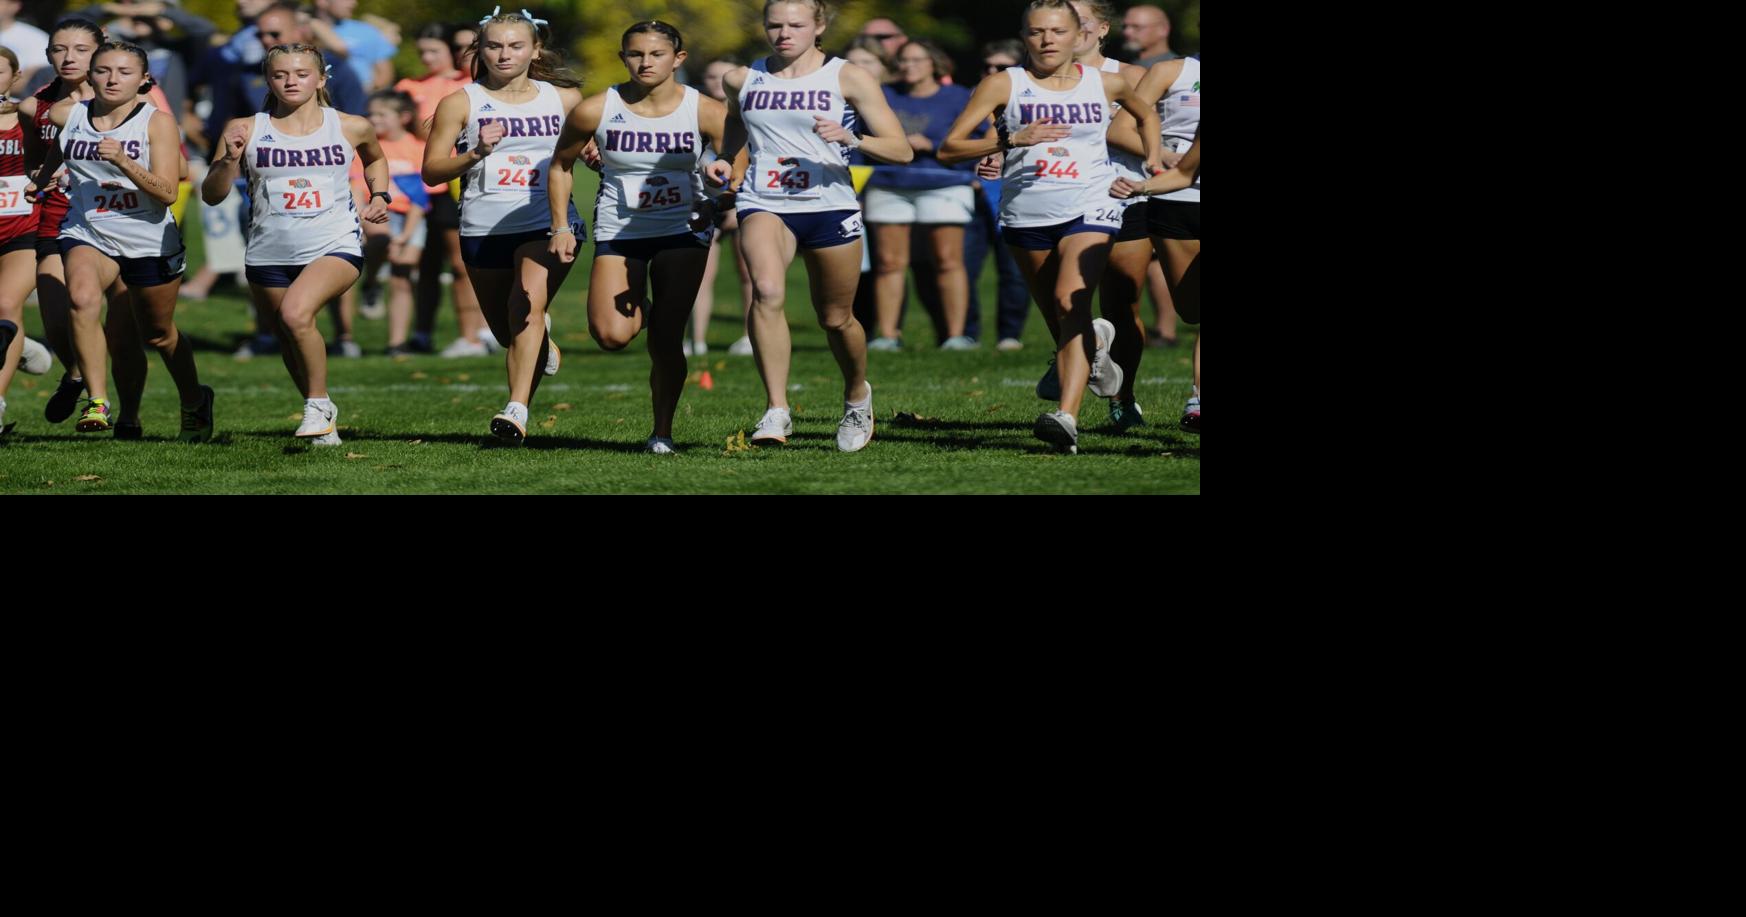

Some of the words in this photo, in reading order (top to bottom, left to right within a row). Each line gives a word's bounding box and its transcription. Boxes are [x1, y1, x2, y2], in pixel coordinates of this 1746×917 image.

[742, 89, 831, 112] NORRIS
[1019, 102, 1102, 124] NORRIS
[63, 139, 141, 161] NORS
[605, 129, 695, 153] NORRIS
[255, 144, 346, 168] NORRIS
[497, 168, 541, 187] 242
[767, 170, 810, 189] 243
[1034, 159, 1079, 179] 244
[94, 191, 139, 213] 240
[282, 190, 321, 210] 241
[638, 186, 681, 209] 245
